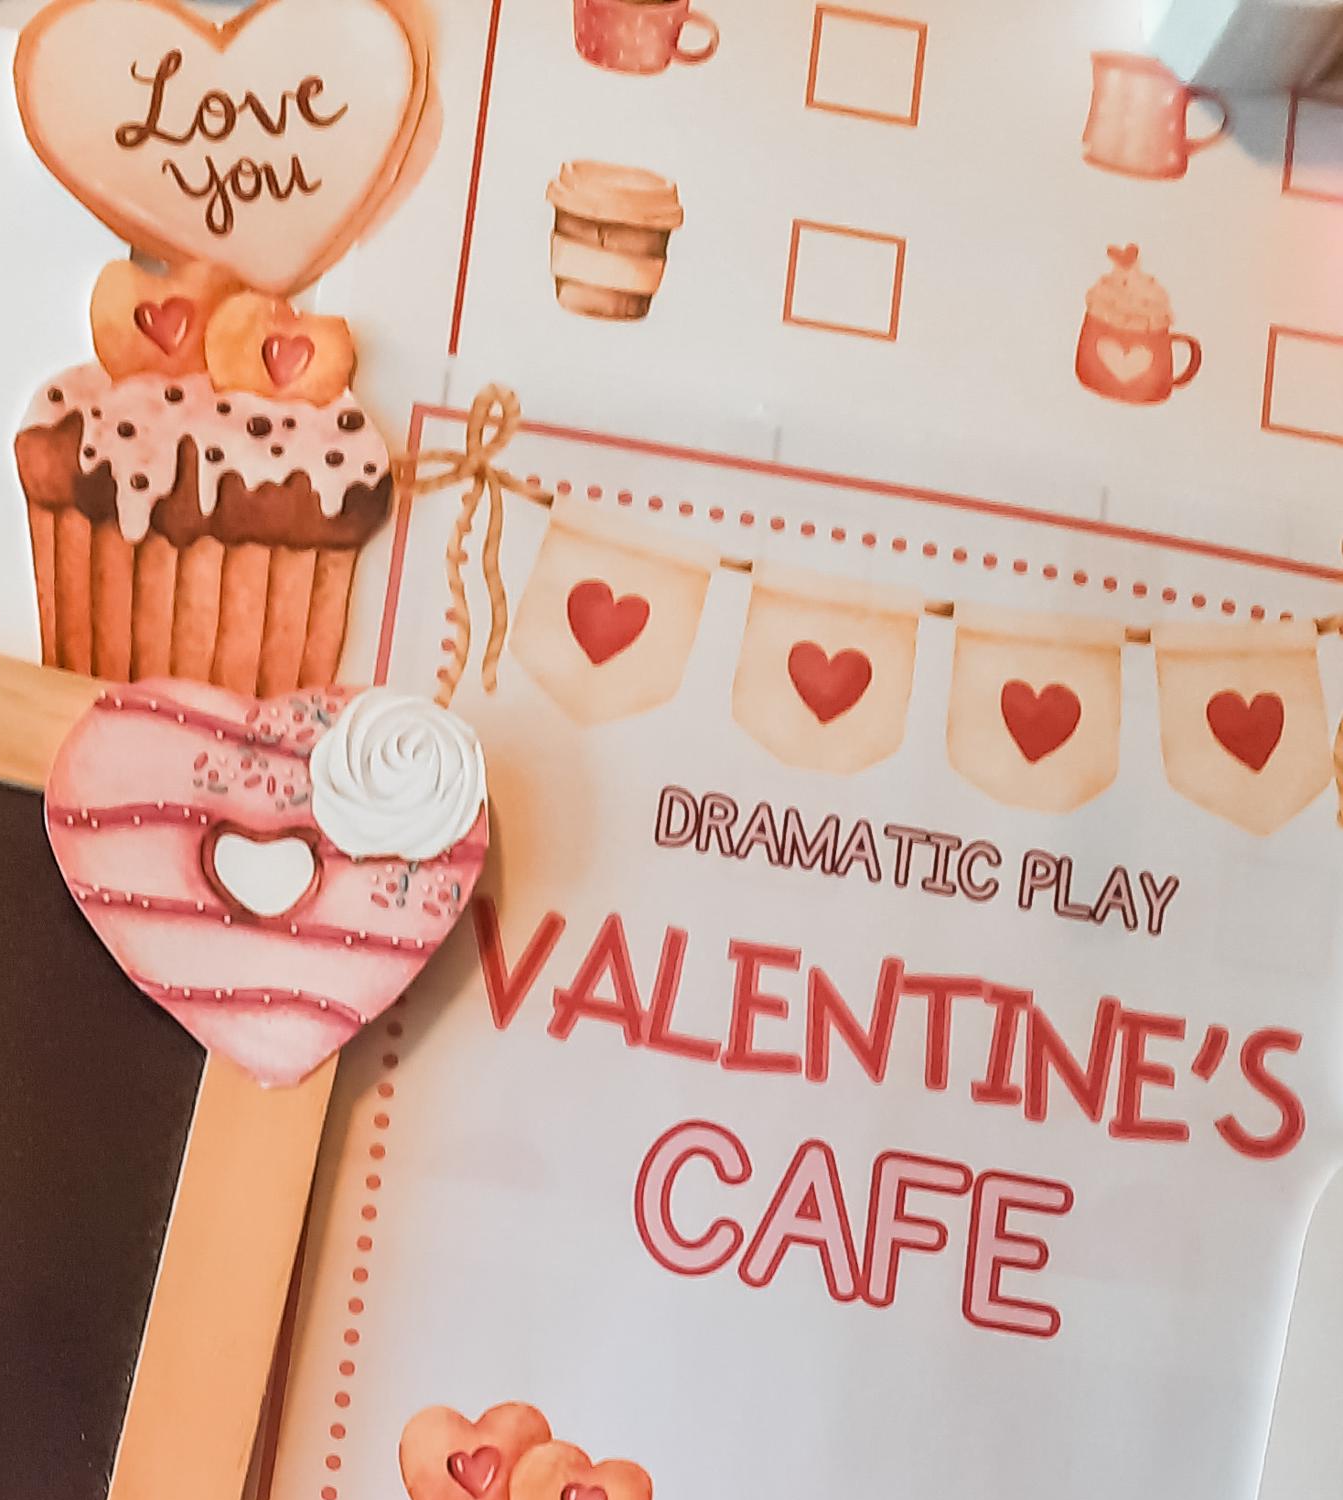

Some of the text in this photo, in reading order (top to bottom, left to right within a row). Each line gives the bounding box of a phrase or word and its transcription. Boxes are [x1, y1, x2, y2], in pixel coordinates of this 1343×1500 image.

[115, 49, 348, 149] Love
[162, 154, 322, 235] you
[654, 785, 1179, 936] DRAMATIC PLAY
[473, 896, 1306, 1160] VALENTINE'S
[634, 1119, 1075, 1338] CAFE
